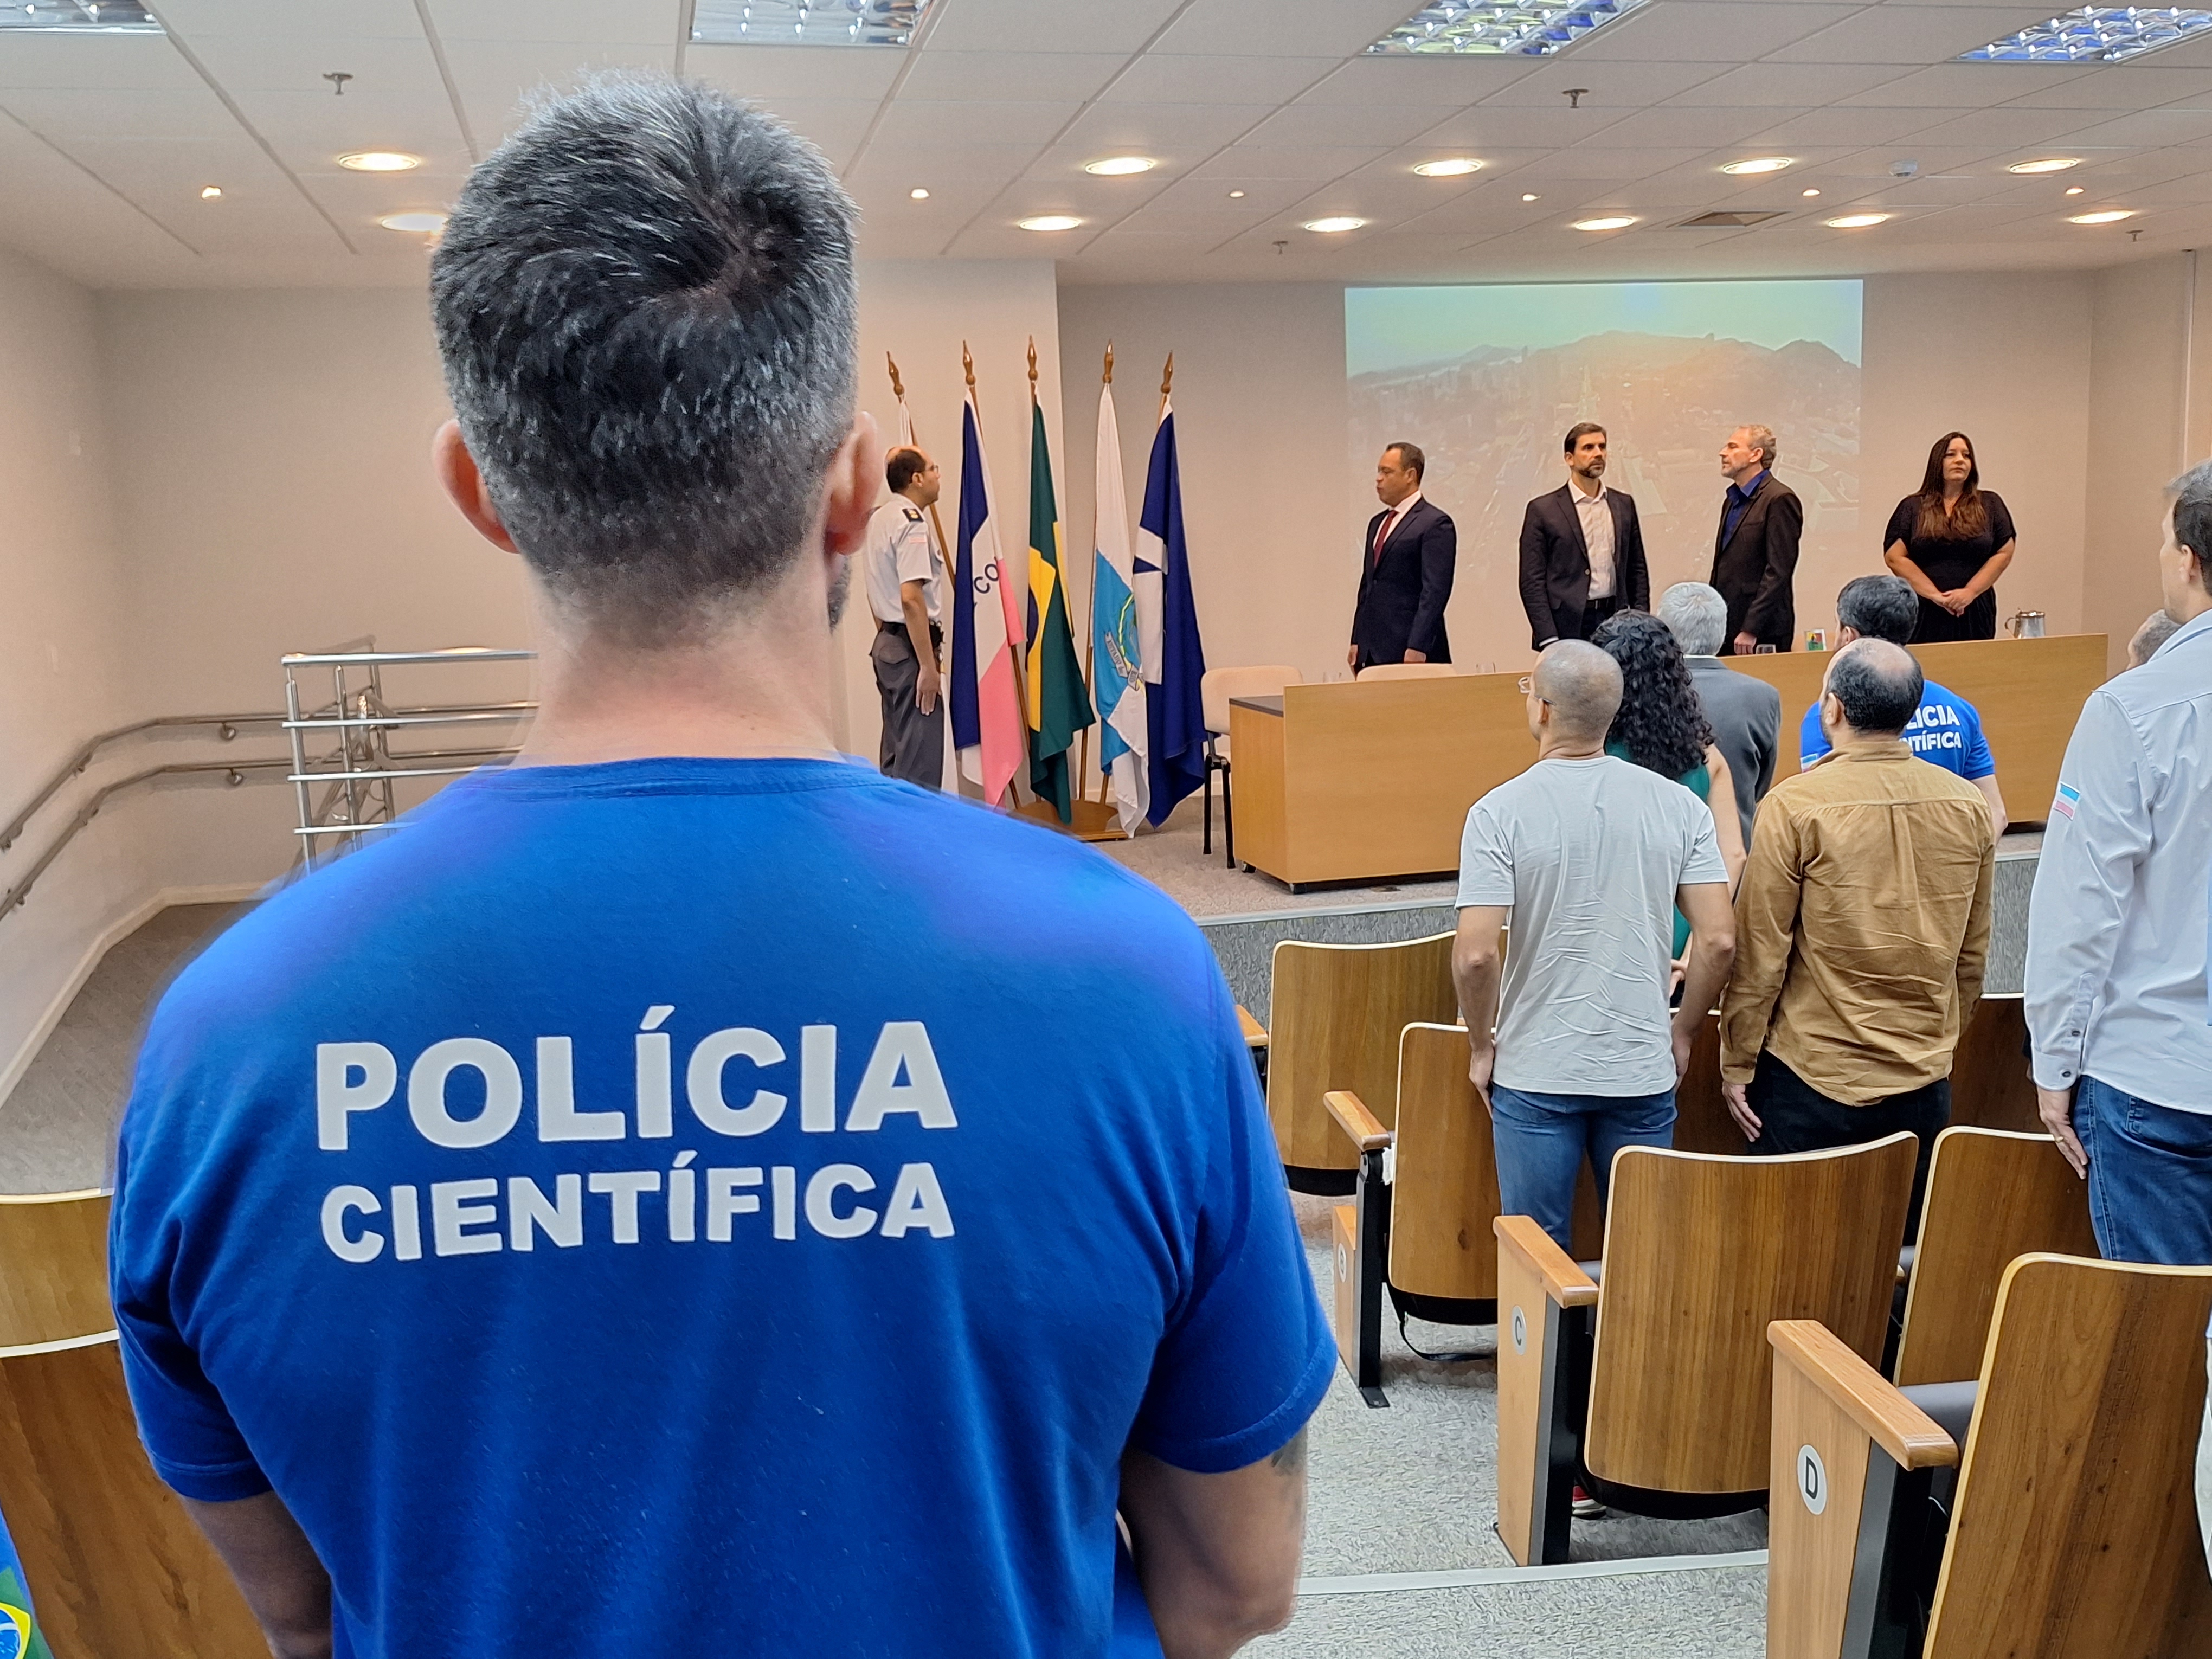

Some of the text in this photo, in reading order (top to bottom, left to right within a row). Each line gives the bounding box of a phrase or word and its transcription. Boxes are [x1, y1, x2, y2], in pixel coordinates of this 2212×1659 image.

[316, 1005, 959, 1150] POLÍCIA
[320, 1150, 955, 1263] CIENTÍFICA
[1515, 1315, 1522, 1346] C
[1805, 1455, 1818, 1500] D
